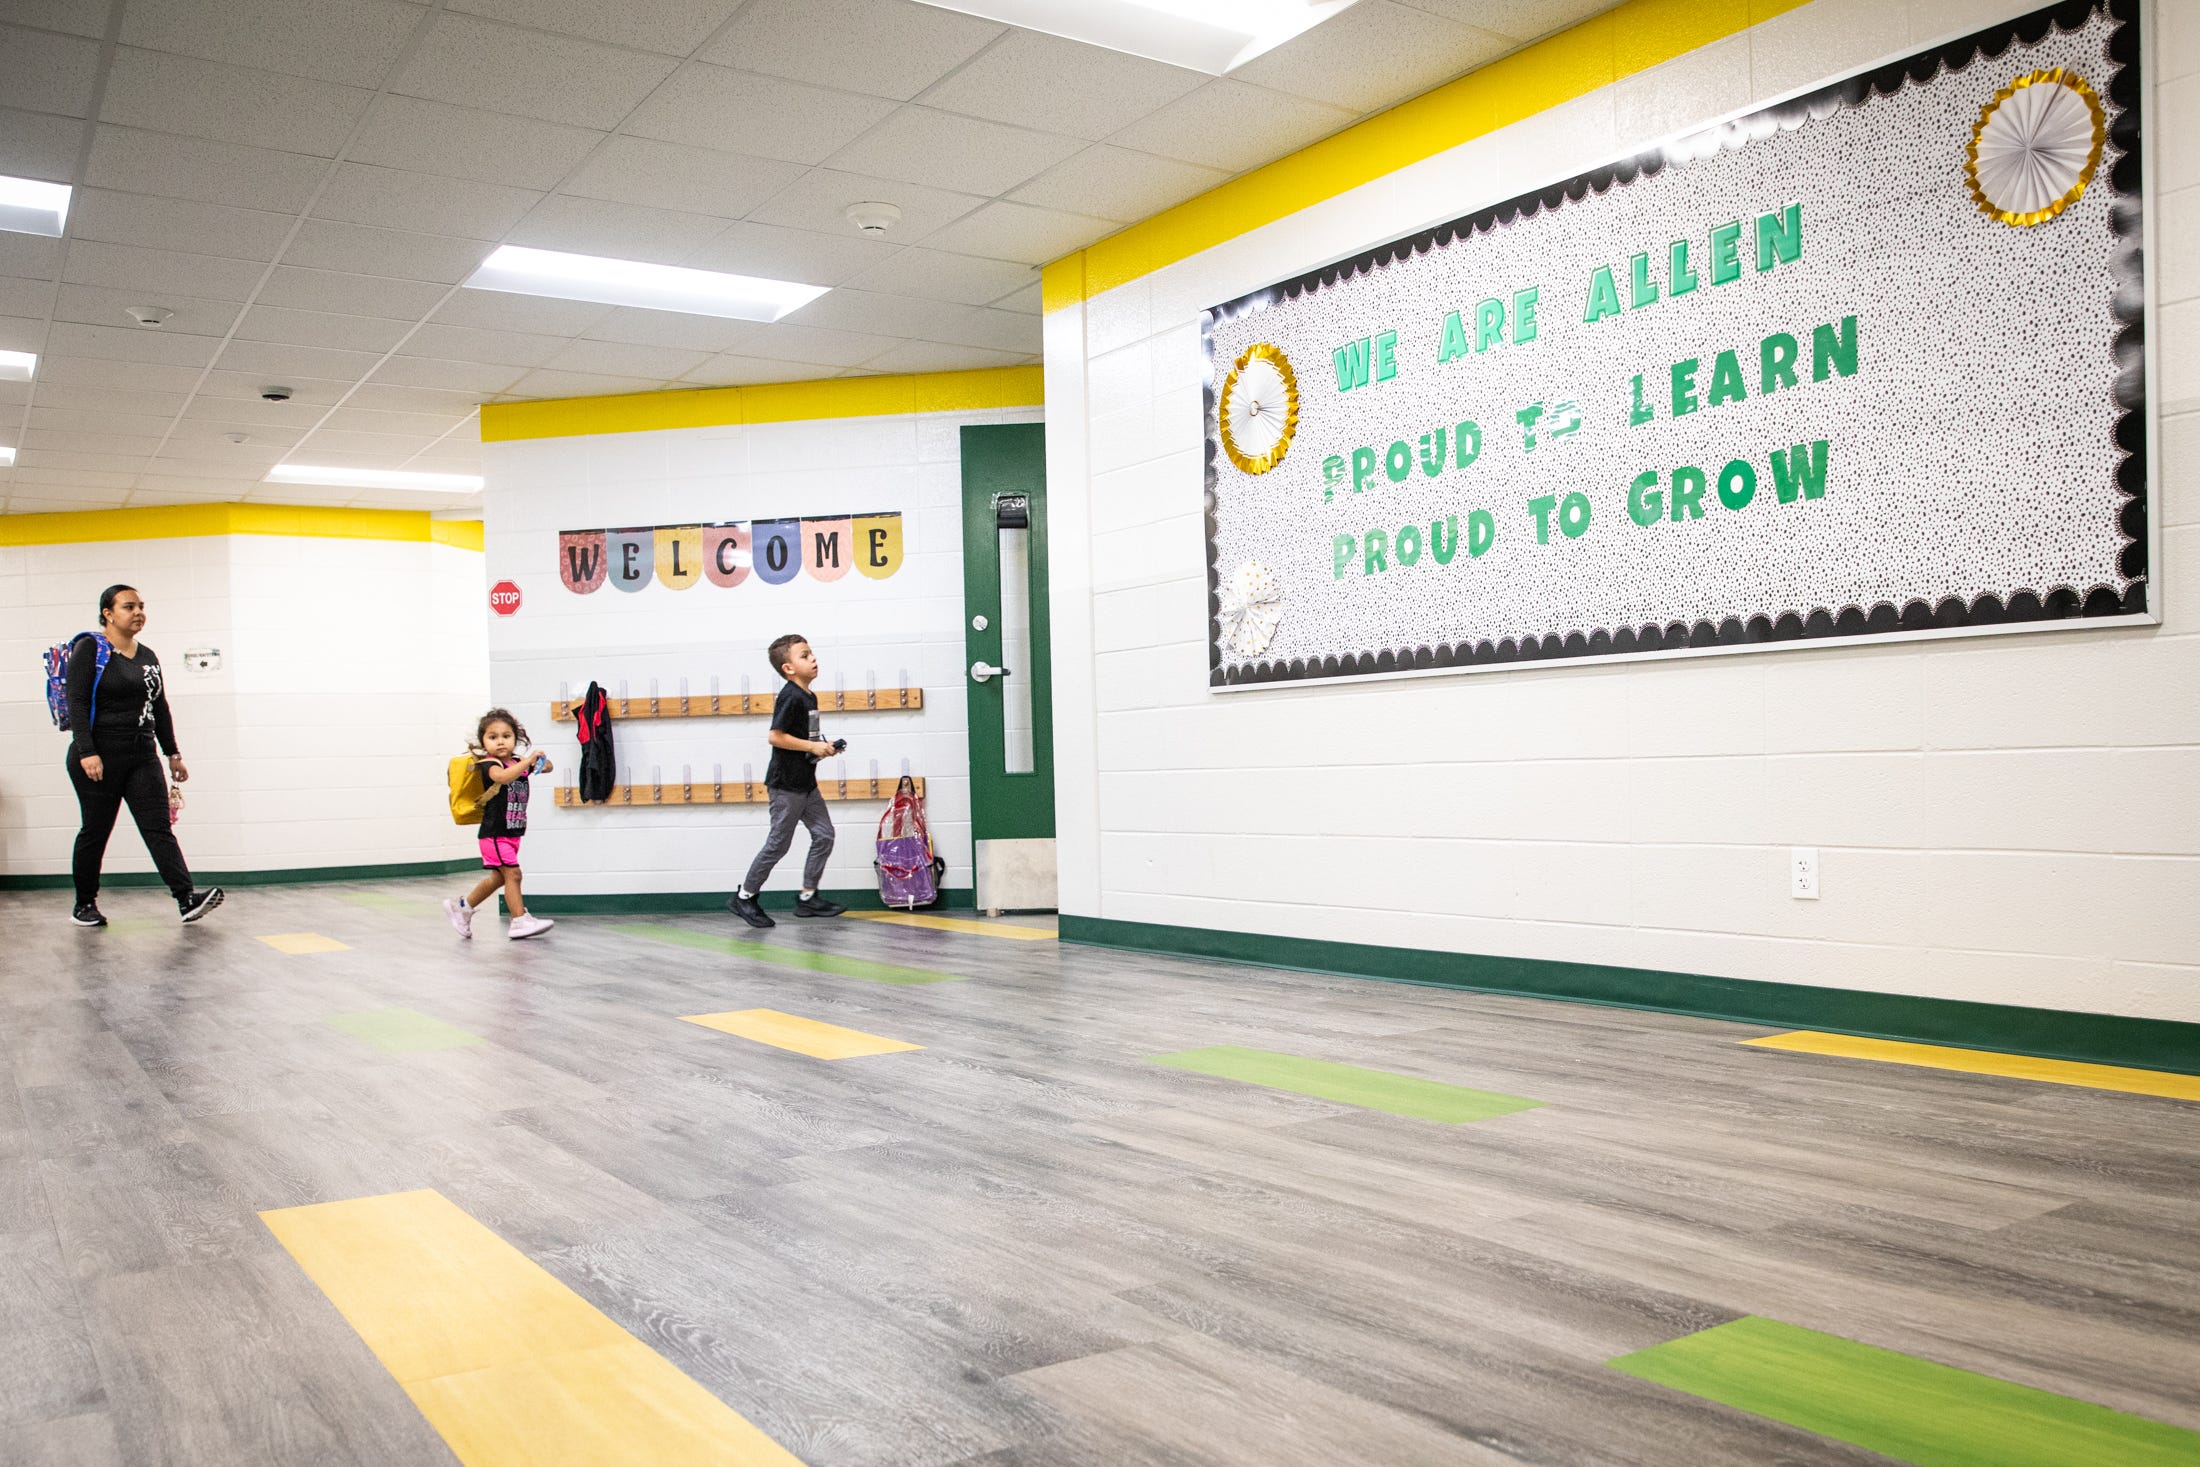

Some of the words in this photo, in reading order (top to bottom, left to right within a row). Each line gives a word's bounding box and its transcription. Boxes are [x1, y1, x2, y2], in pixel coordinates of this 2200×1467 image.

[1332, 329, 1398, 392] WE
[1437, 286, 1539, 363] ARE
[1582, 202, 1802, 323] ALLEN
[1321, 420, 1482, 502] PROUD
[1628, 315, 1858, 427] LEARN
[568, 528, 888, 582] WELCOME
[1332, 508, 1495, 581] PROUD
[1527, 491, 1592, 545] TO
[1627, 439, 1829, 527] GROW
[491, 592, 519, 605] STOP
